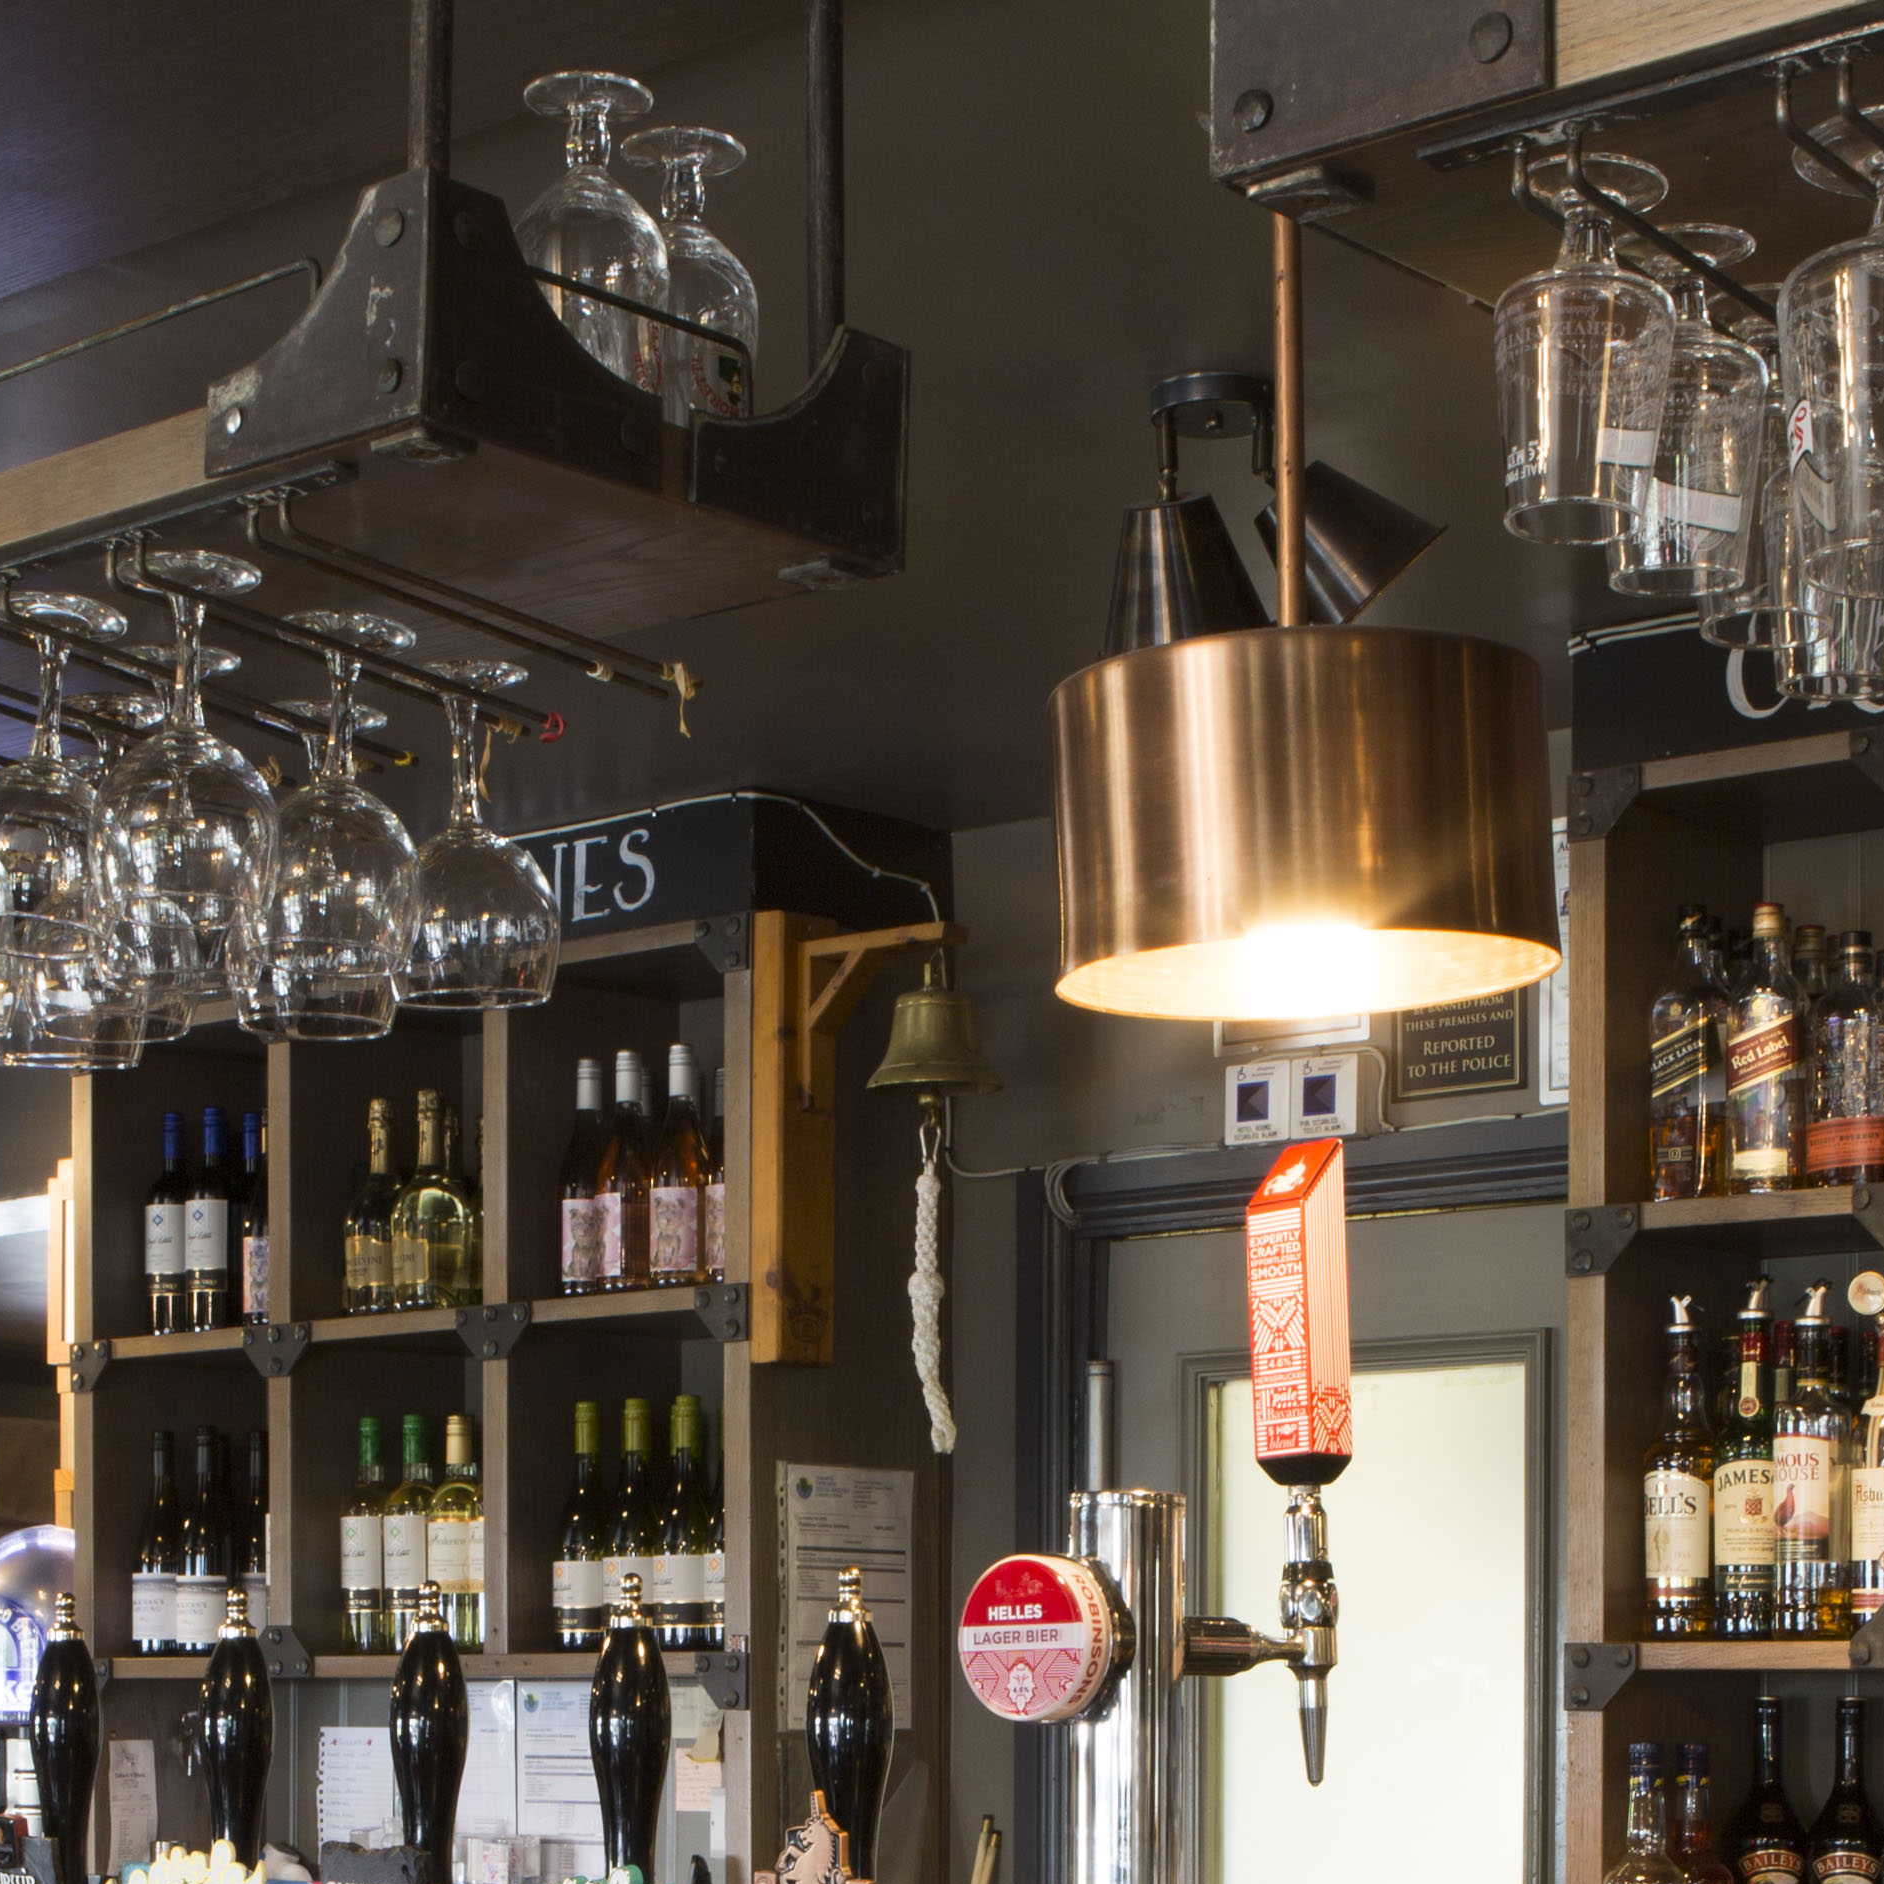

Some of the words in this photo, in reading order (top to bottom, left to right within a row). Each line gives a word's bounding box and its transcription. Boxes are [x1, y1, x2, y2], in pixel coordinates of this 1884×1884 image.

[1426, 999, 1471, 1016] BANNED
[1473, 995, 1505, 1009] FROM
[1404, 1018, 1438, 1032] THESE
[1439, 1012, 1490, 1030] PREMISES
[1492, 1008, 1514, 1023] AND
[1422, 1034, 1496, 1057] REPORTED
[1731, 1050, 1756, 1070] Red
[1757, 1035, 1791, 1060] Label
[1407, 1063, 1427, 1079] TO
[1430, 1059, 1461, 1077] THE
[1463, 1053, 1512, 1072] POLICE
[1839, 1131, 1881, 1141] BOURBON
[1249, 1229, 1301, 1248] EXPERTLY
[1250, 1241, 1301, 1259] CRAFTED
[1250, 1253, 1301, 1267] EFFORTLESSLY
[1251, 1262, 1303, 1280] SMOOTH
[1268, 1356, 1292, 1369] 4.6%
[1255, 1372, 1306, 1385] HERSBRUCKER
[1267, 1408, 1306, 1420] Bavaria
[1268, 1427, 1275, 1436] 5
[1276, 1424, 1298, 1434] HOP
[1269, 1435, 1296, 1450] blend
[988, 1604, 1043, 1621] HELLES
[973, 1630, 1021, 1645] LAGER
[1026, 1629, 1059, 1642] BIER
[1067, 1573, 1103, 1705] ROBINSONS
[1743, 1854, 1803, 1872] BAILEYS
[1816, 1857, 1877, 1874] BAILEYS
